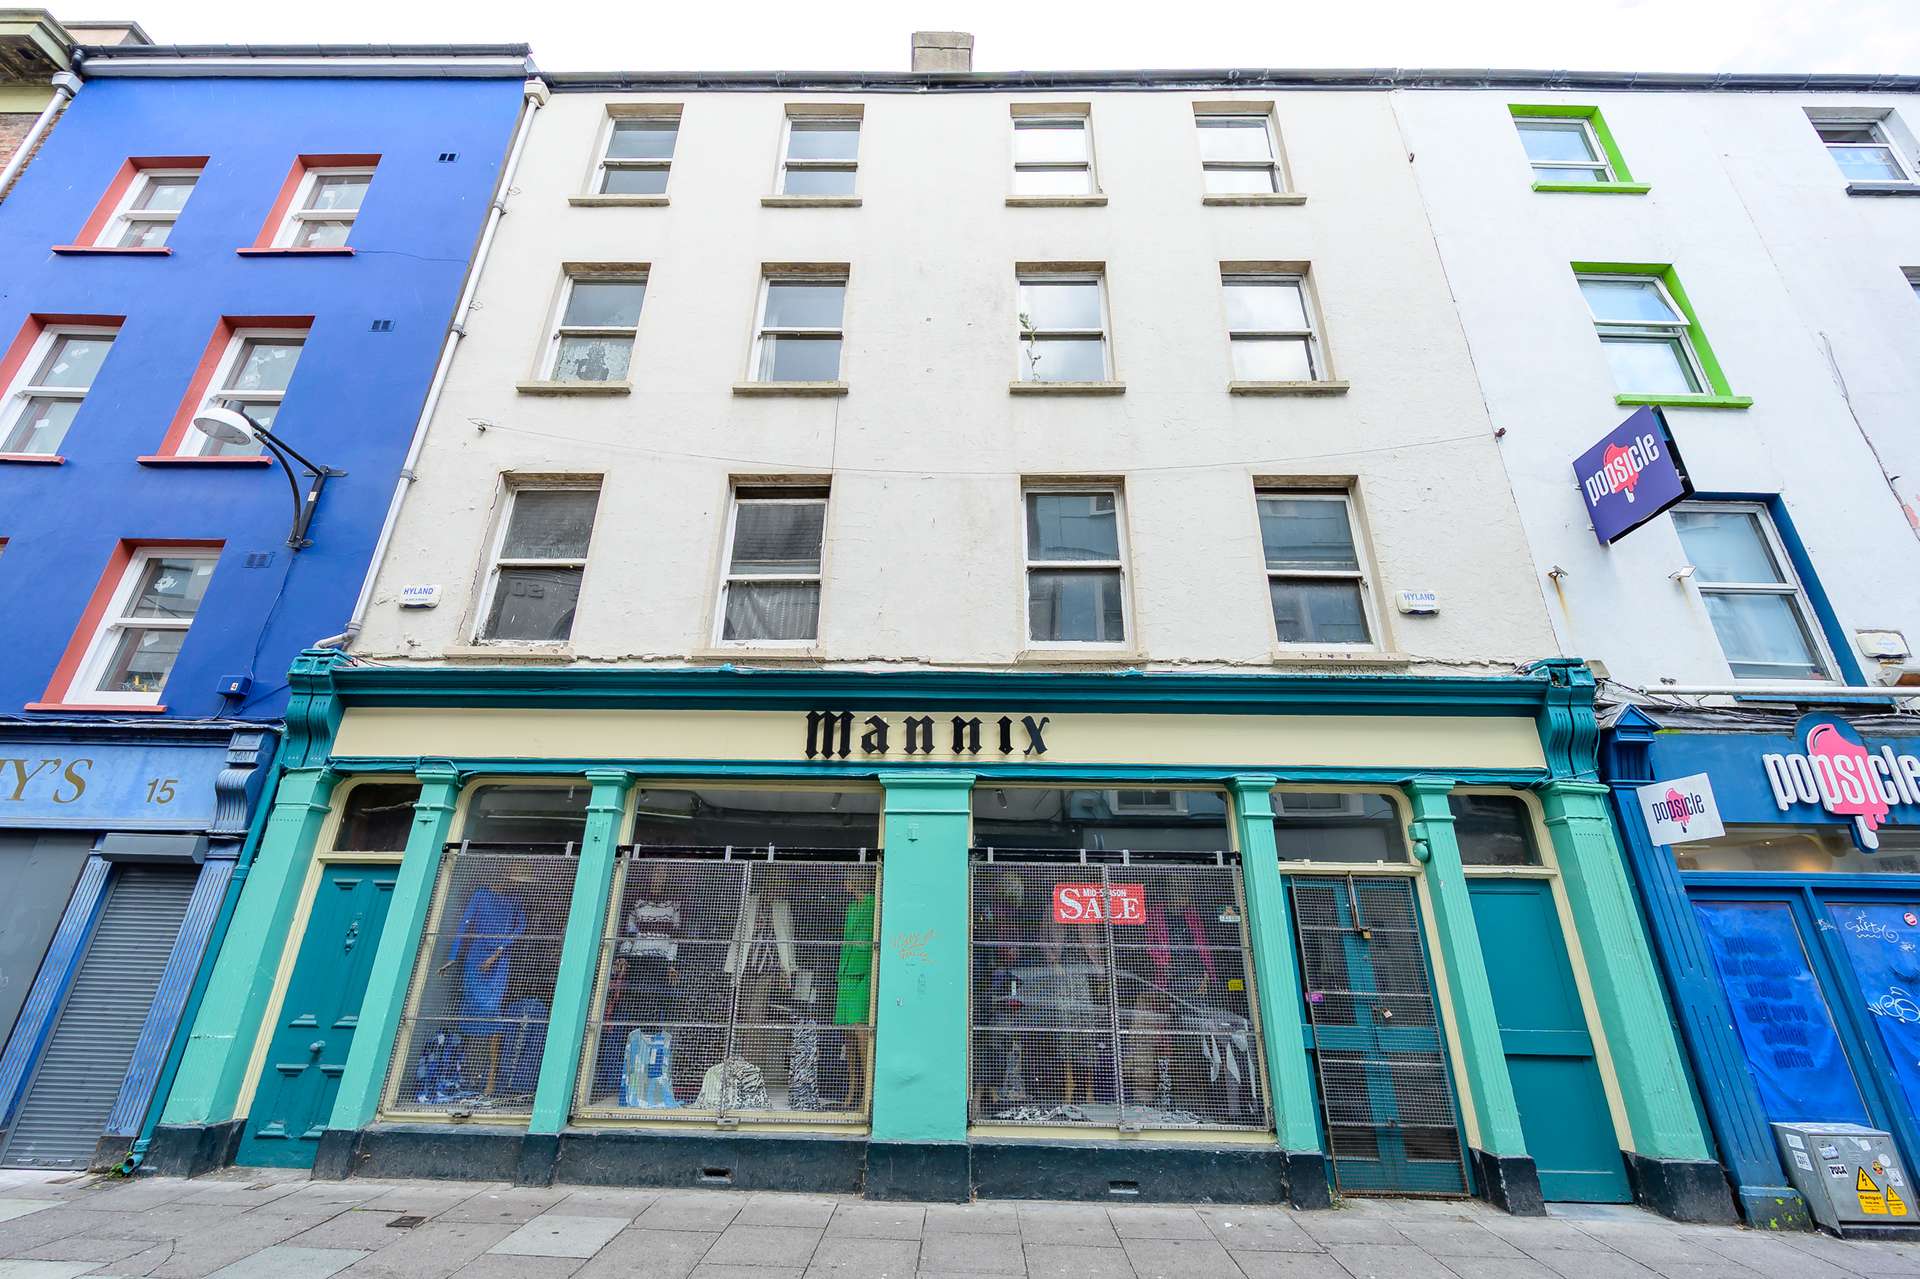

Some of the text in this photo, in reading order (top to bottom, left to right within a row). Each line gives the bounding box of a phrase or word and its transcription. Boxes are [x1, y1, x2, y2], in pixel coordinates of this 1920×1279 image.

[1585, 433, 1660, 507] popsicle
[404, 587, 434, 595] HYLAND
[1403, 593, 1435, 601] HYLAND
[0, 758, 94, 804] Y'S
[146, 778, 178, 804] 15
[1652, 792, 1705, 824] popsicle
